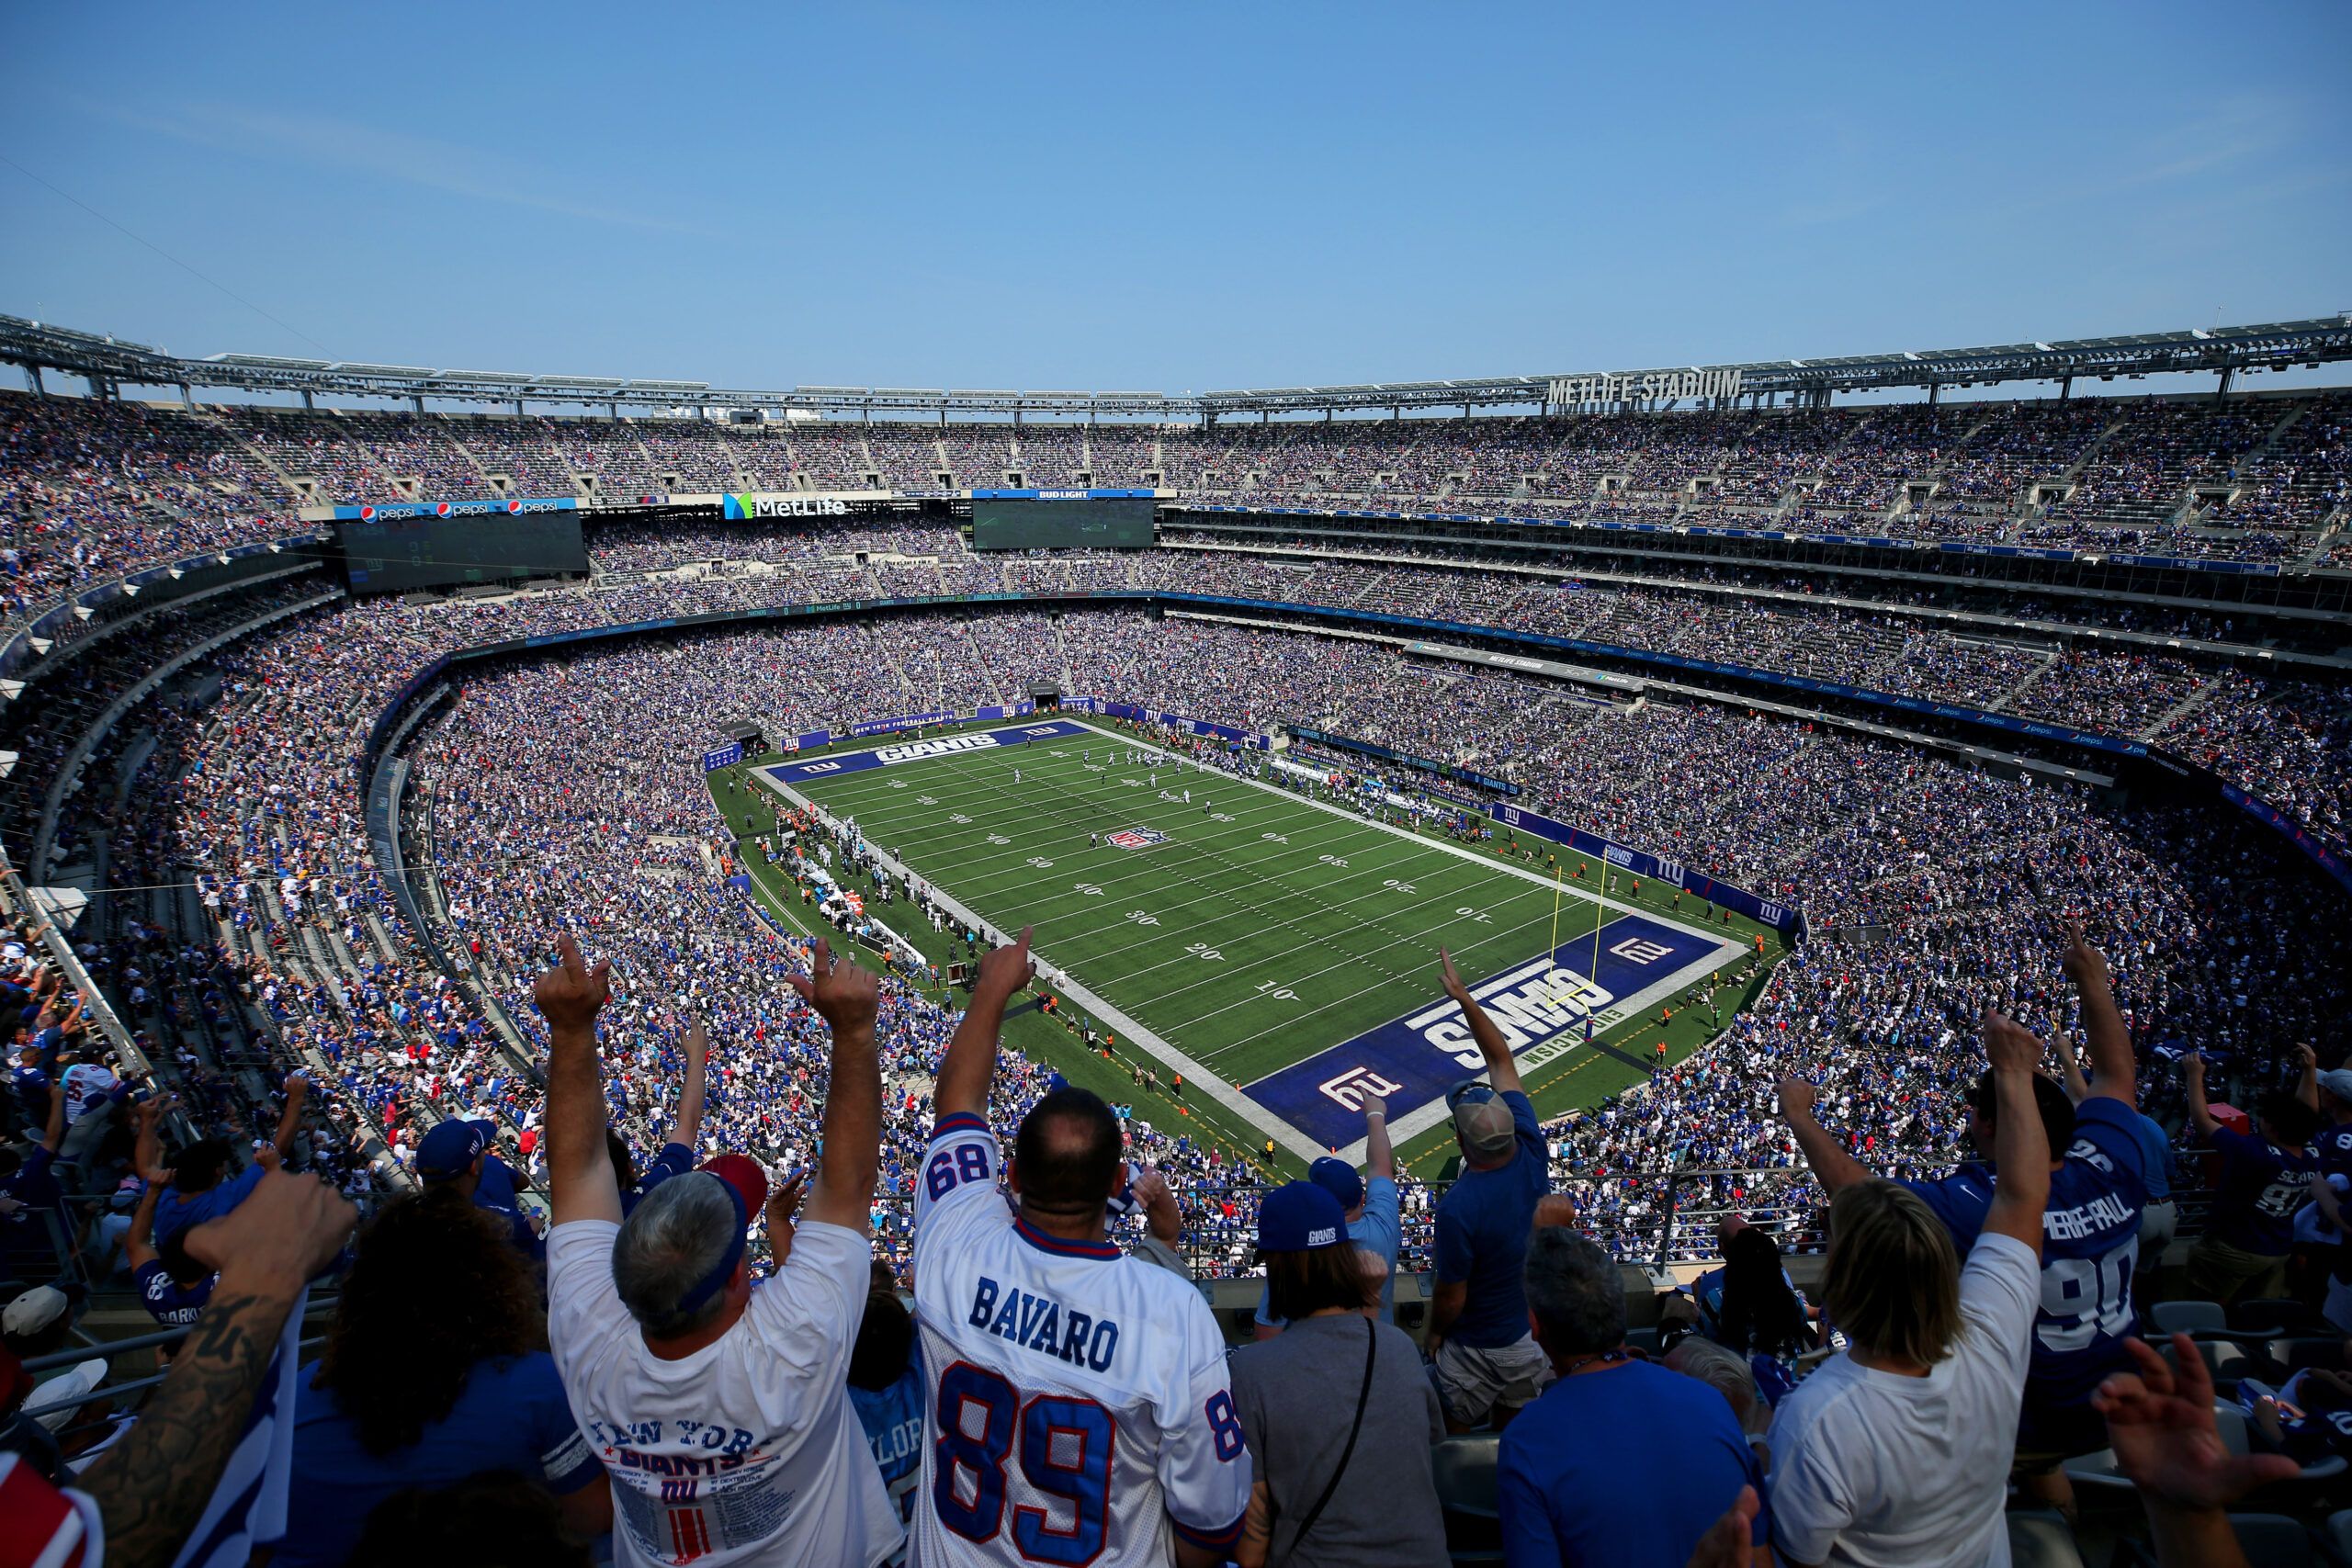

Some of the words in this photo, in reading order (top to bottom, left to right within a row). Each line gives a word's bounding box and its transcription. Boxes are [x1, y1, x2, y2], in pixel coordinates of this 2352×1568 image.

[1548, 375, 1635, 405] METLIFE
[1641, 369, 1742, 402] STADIUM
[1039, 491, 1059, 499] BUD
[1060, 491, 1088, 499] LIGHT
[379, 506, 415, 521] pepsi
[453, 502, 488, 516] pepsi
[524, 501, 558, 514] pepsi
[756, 494, 846, 517] MetLife
[1488, 654, 1514, 665] METLIFE
[1515, 658, 1544, 669] STADIUM
[1605, 675, 1629, 684] MetLife
[1824, 684, 1840, 693] pepsi
[1860, 692, 1877, 700] pepsi
[1899, 699, 1917, 708] pepsi
[1940, 706, 1960, 716] pepsi
[892, 717, 925, 728] FOOTBALL
[1984, 716, 2005, 727] pepsi
[1022, 726, 1059, 736] ny
[1297, 728, 1320, 739] PANTHERS
[2030, 725, 2052, 736] pepsi
[876, 734, 999, 763] GIANTS
[1935, 739, 1961, 751] verizon
[2080, 735, 2103, 747] pepsi
[799, 761, 842, 773] ny
[1319, 757, 1340, 766] FOOTBAL
[1483, 777, 1507, 791] GIANTS
[1504, 807, 1520, 825] ny
[1110, 831, 1141, 848] NFL
[1025, 856, 1054, 868] 50
[1605, 844, 1634, 865] GIANTS
[1657, 858, 1684, 889] ny
[1073, 883, 1102, 895] 40
[1383, 879, 1417, 894] 20
[1125, 909, 1158, 925] 30
[1455, 907, 1493, 923] 10
[1759, 900, 1782, 925] ny
[1183, 942, 1221, 960] 20
[1254, 979, 1295, 1000] 10
[1423, 967, 1614, 1070] GIANS
[1591, 1008, 1625, 1029] END
[1521, 1025, 1588, 1066] RACISM
[1308, 1227, 1337, 1244] GIANTS
[2036, 1233, 2140, 1352] 90
[158, 1306, 205, 1324] BARK
[968, 1276, 1120, 1373] BAVARO
[1204, 1388, 1246, 1462] 8
[675, 1419, 773, 1455] YOR
[619, 1449, 745, 1476] GIANTS
[934, 1359, 1116, 1568] 89
[661, 1480, 698, 1505] ny
